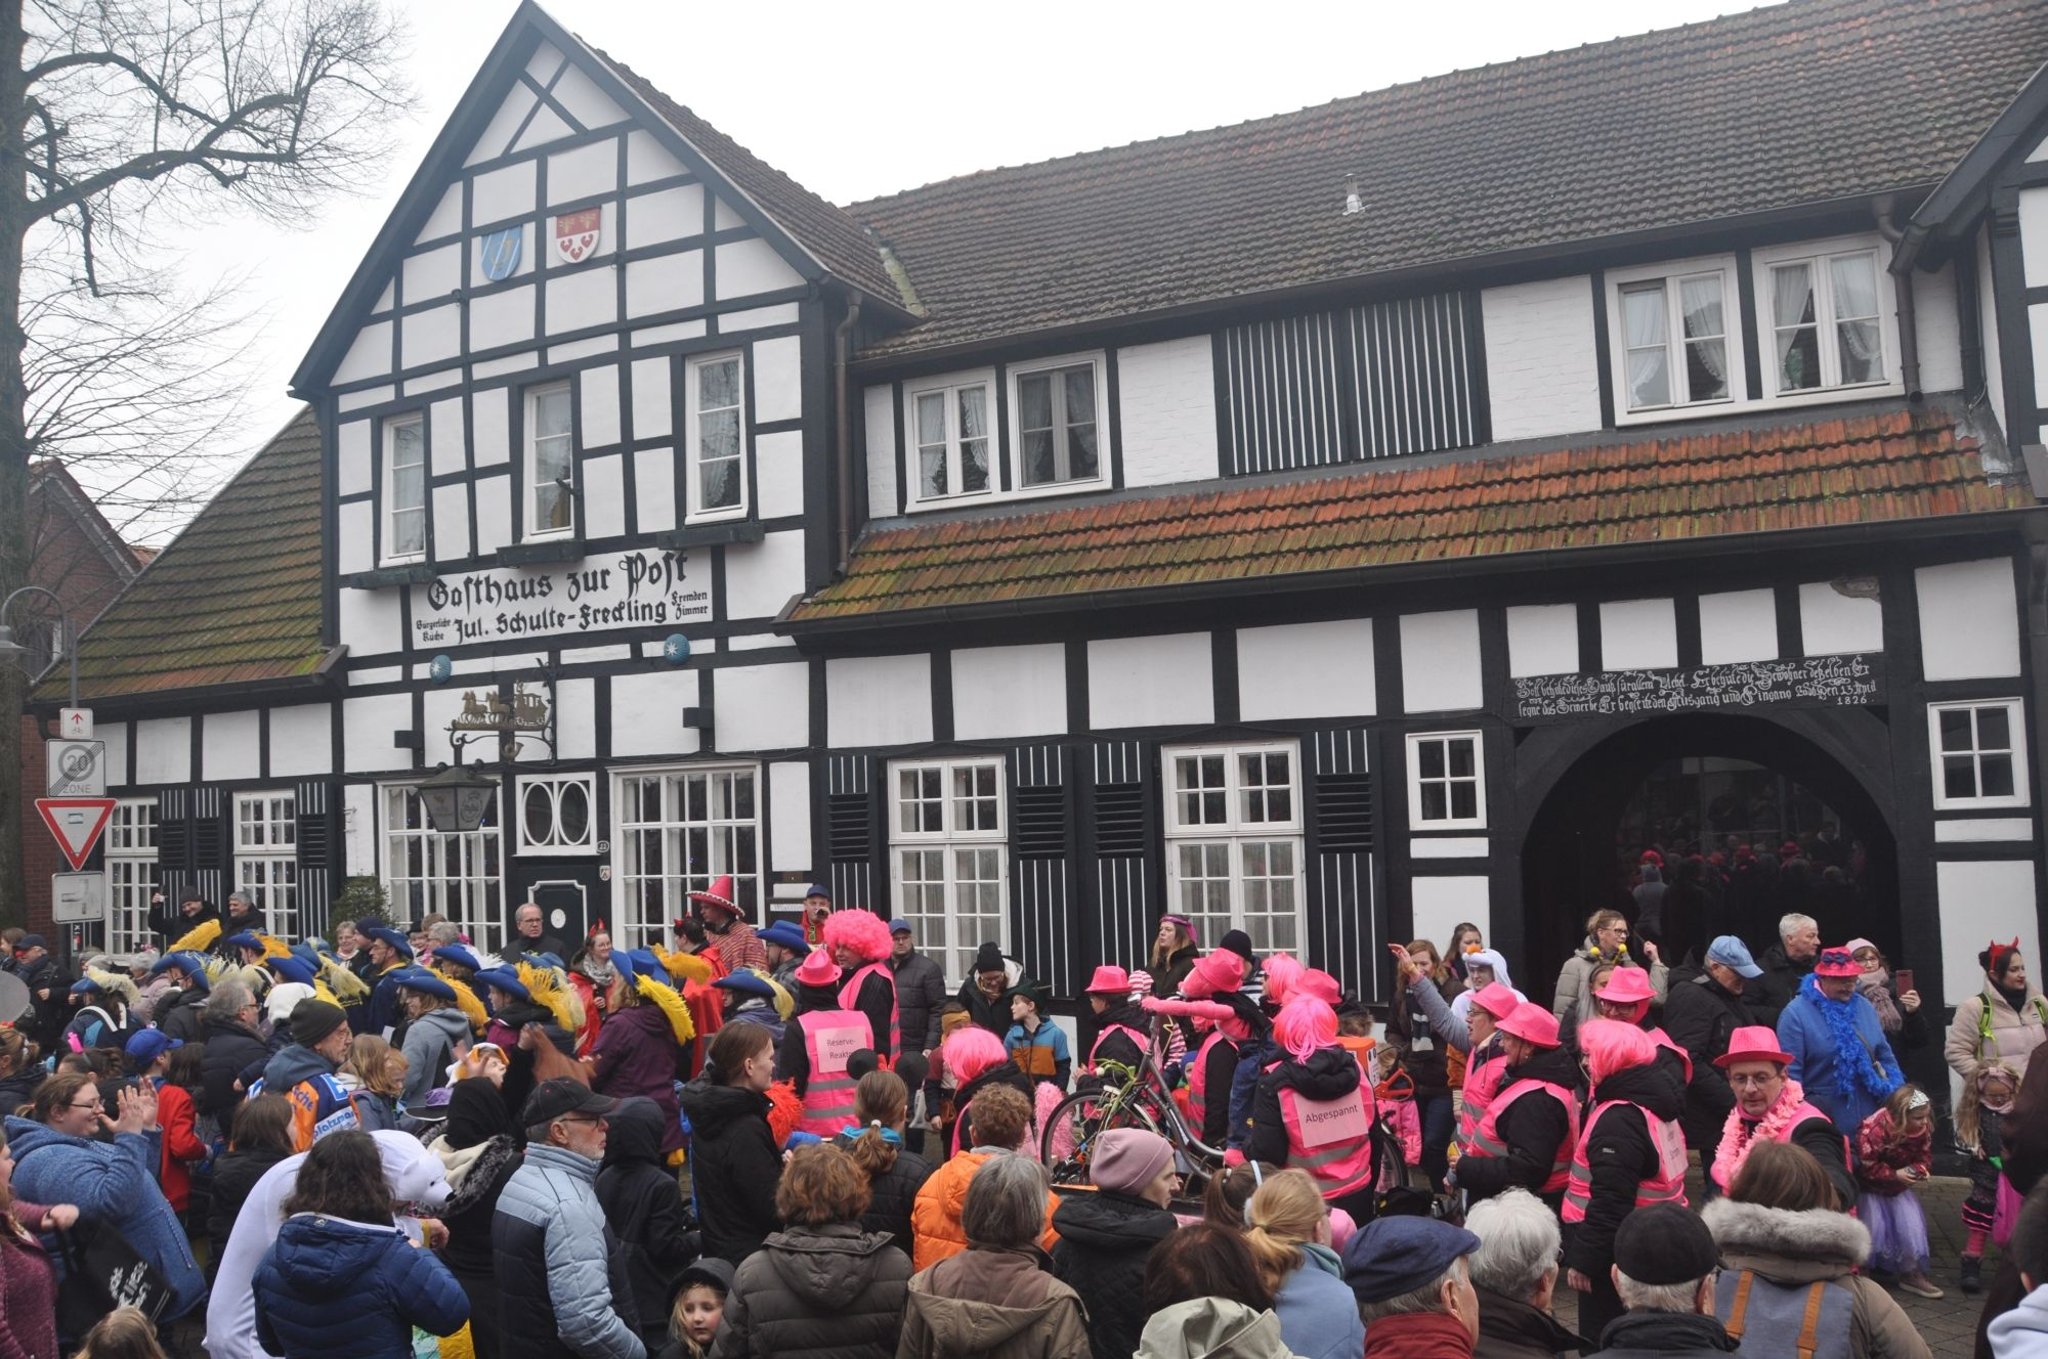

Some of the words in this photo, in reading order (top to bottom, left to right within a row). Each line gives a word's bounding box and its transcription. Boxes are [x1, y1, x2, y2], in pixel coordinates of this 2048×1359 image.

[427, 572, 552, 614] Gasthaus
[566, 566, 611, 602] zur
[618, 551, 688, 600] Post
[671, 590, 707, 606] Fremden
[675, 603, 709, 620] Zimmer
[453, 618, 488, 644] Jul.
[67, 755, 88, 772] 20
[62, 784, 92, 794] ZONE
[1305, 1105, 1358, 1123] Abgespannt
